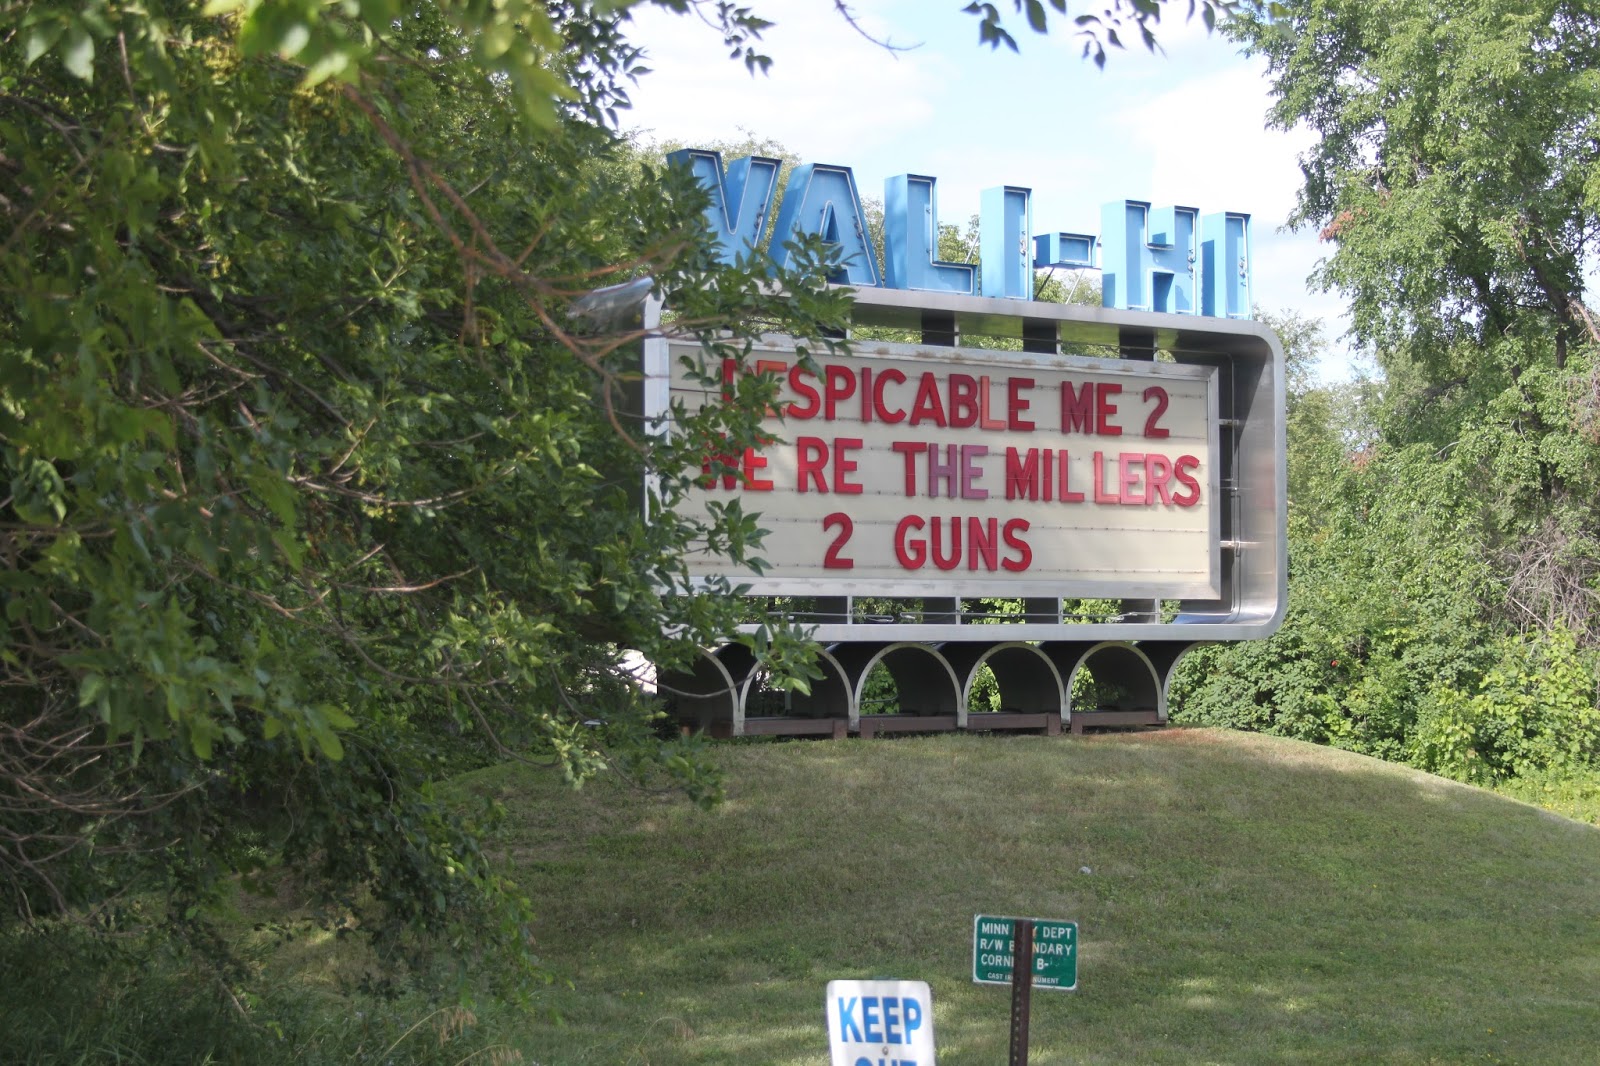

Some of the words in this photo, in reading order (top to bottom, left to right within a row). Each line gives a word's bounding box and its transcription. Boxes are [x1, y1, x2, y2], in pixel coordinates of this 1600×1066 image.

[1061, 380, 1123, 436] ME
[1143, 386, 1170, 438] 2
[797, 436, 864, 494] RE
[892, 441, 989, 500] THE
[1006, 447, 1200, 507] MILLERS
[823, 512, 854, 569] 2
[895, 514, 1033, 572] GUNS
[980, 938, 1003, 951] R/W
[981, 922, 1009, 935] MINN
[1042, 926, 1072, 939] DEPT
[980, 953, 1014, 967] CORN
[987, 972, 1003, 980] CAST
[838, 996, 922, 1044] KEEP
